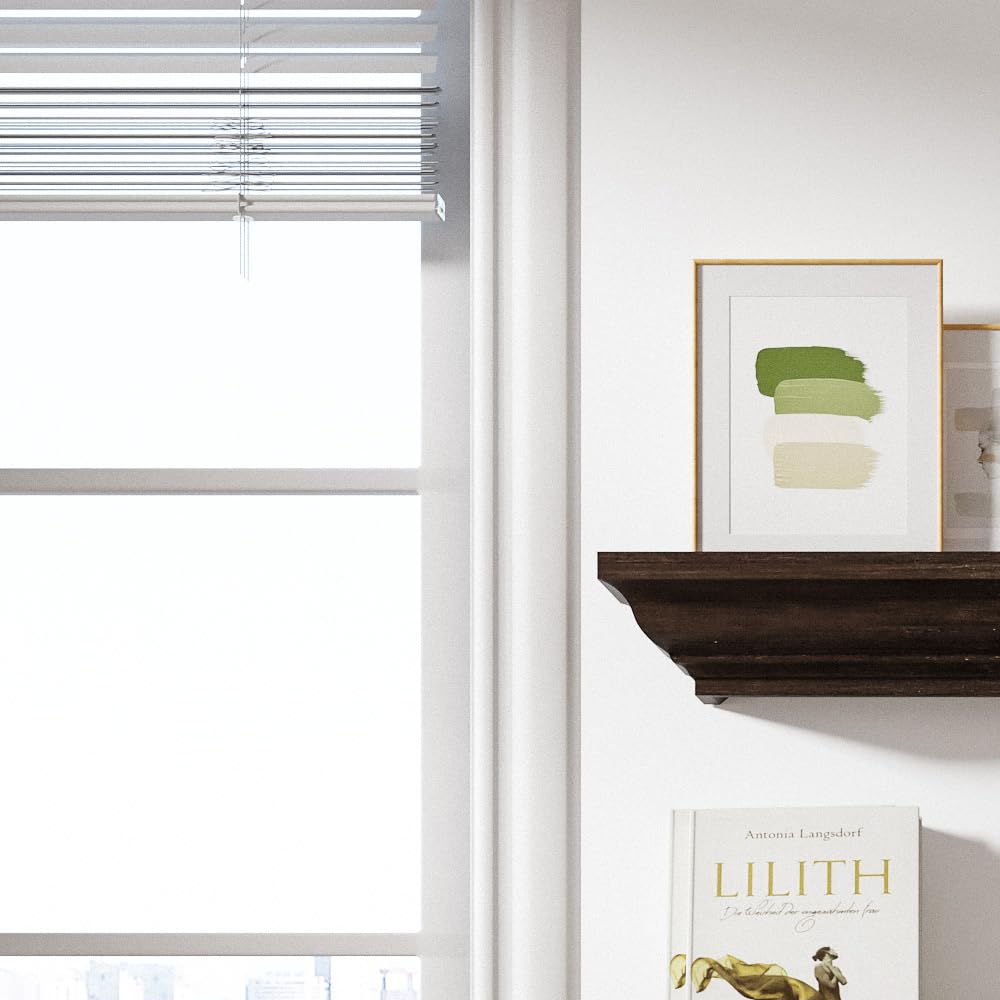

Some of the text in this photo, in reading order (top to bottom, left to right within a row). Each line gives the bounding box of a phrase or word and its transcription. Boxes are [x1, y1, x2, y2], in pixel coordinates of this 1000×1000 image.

[745, 827, 864, 841] Antonia Langsdorf
[714, 858, 893, 898] LILITH
